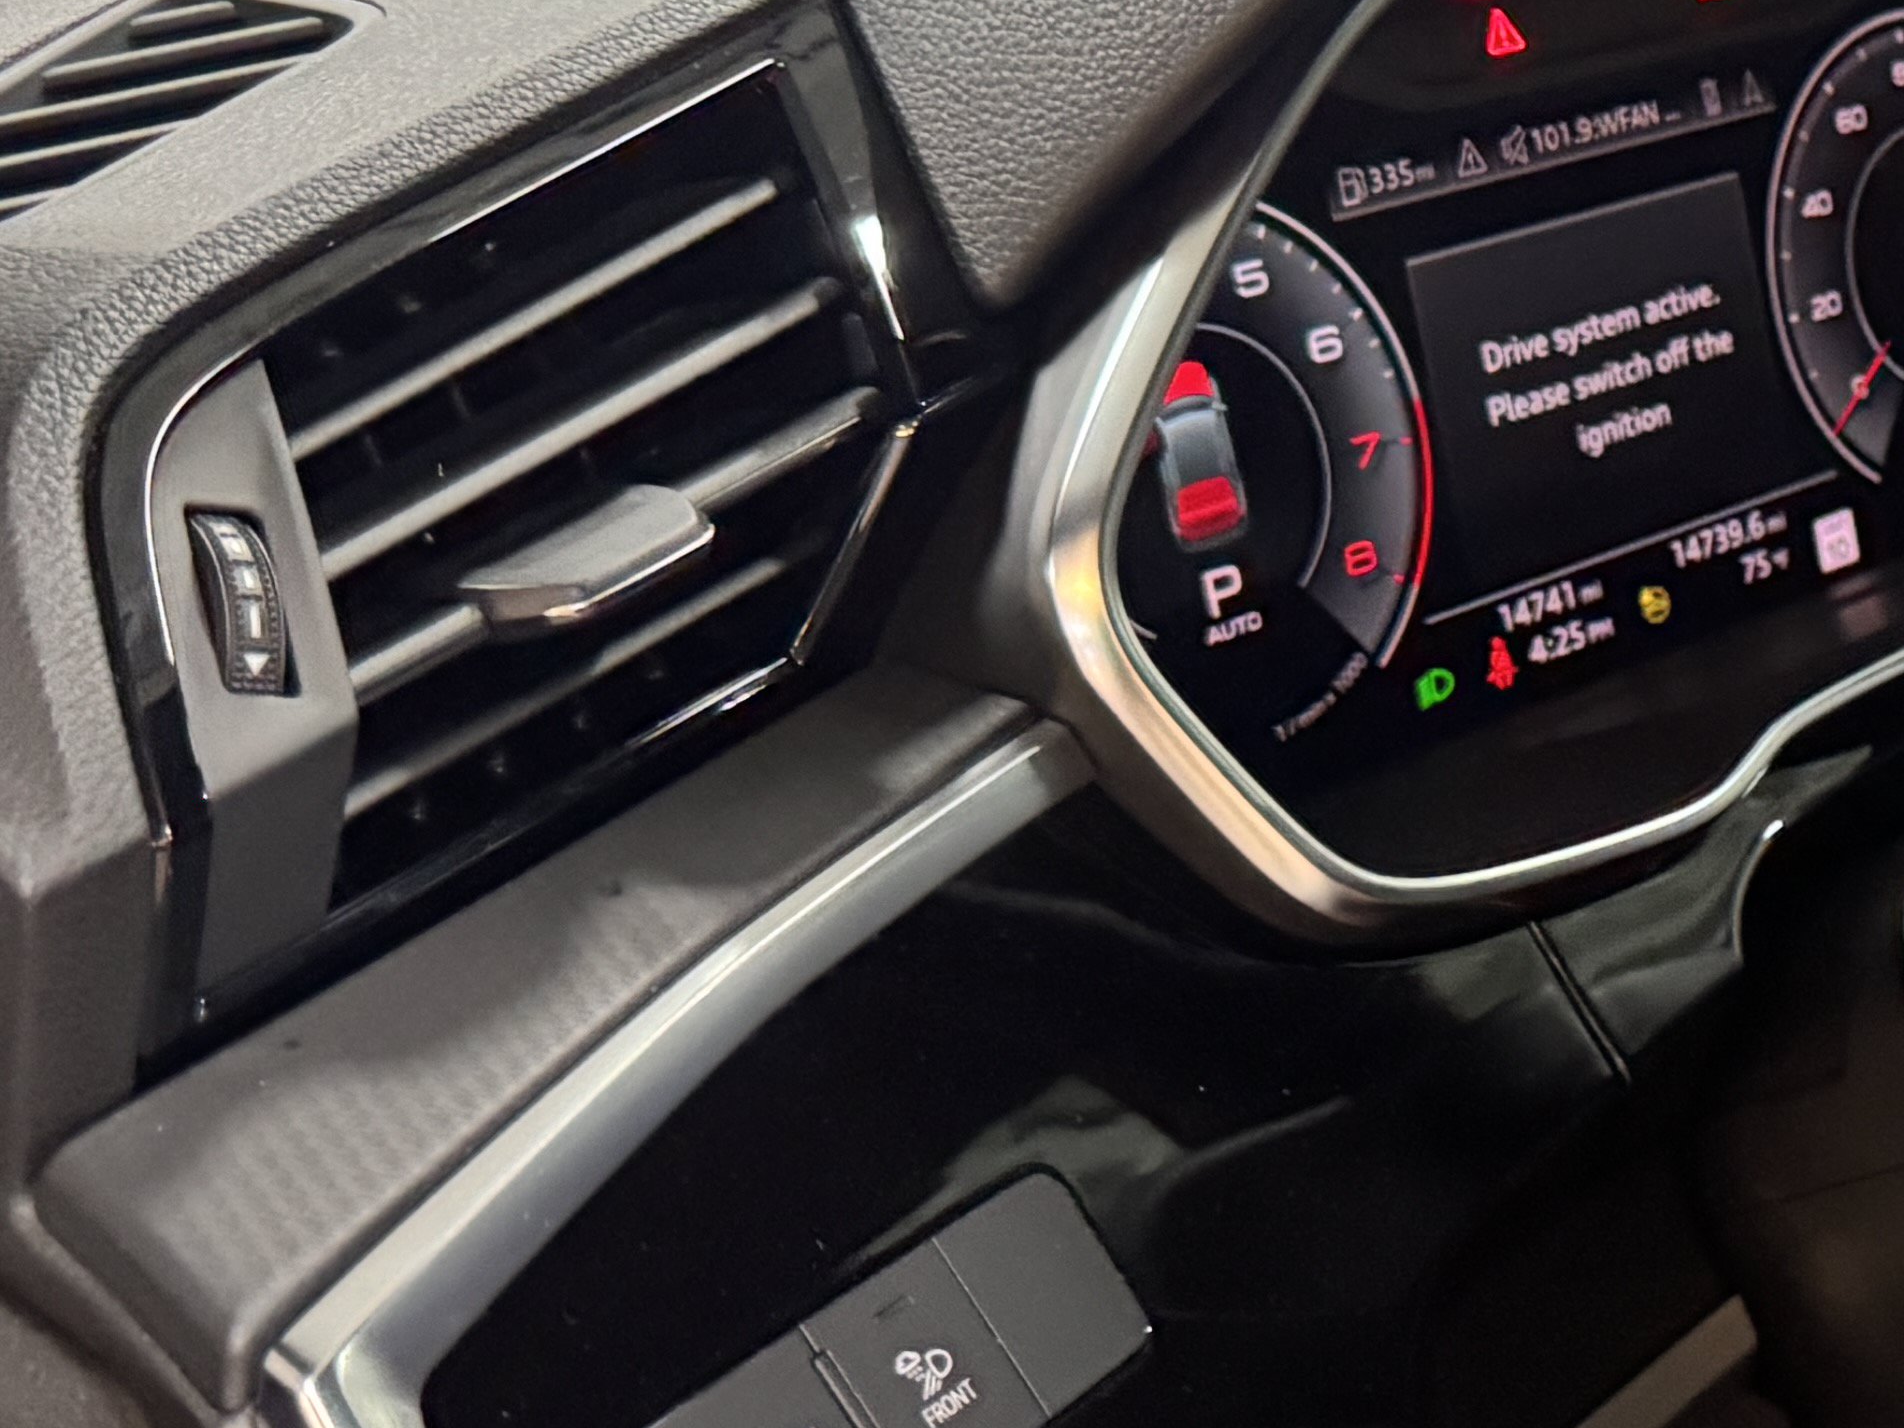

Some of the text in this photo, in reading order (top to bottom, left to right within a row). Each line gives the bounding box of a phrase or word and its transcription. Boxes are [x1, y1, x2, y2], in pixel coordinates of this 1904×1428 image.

[1368, 158, 1413, 195] 335
[1800, 189, 1834, 219] 40
[1230, 258, 1270, 299] 5
[1810, 290, 1843, 322] 20
[1306, 324, 1344, 364] 6
[1480, 282, 1721, 374] Drive system active.
[1486, 328, 1735, 427] Please switch off the
[1575, 402, 1673, 458] ignition
[1349, 431, 1382, 470] 7
[1343, 540, 1378, 577] 8
[1669, 510, 1765, 569] 14739.6
[1739, 549, 1772, 585] 75
[1201, 564, 1242, 619] P
[1497, 580, 1578, 632] 14741
[1206, 611, 1263, 646] AUTO
